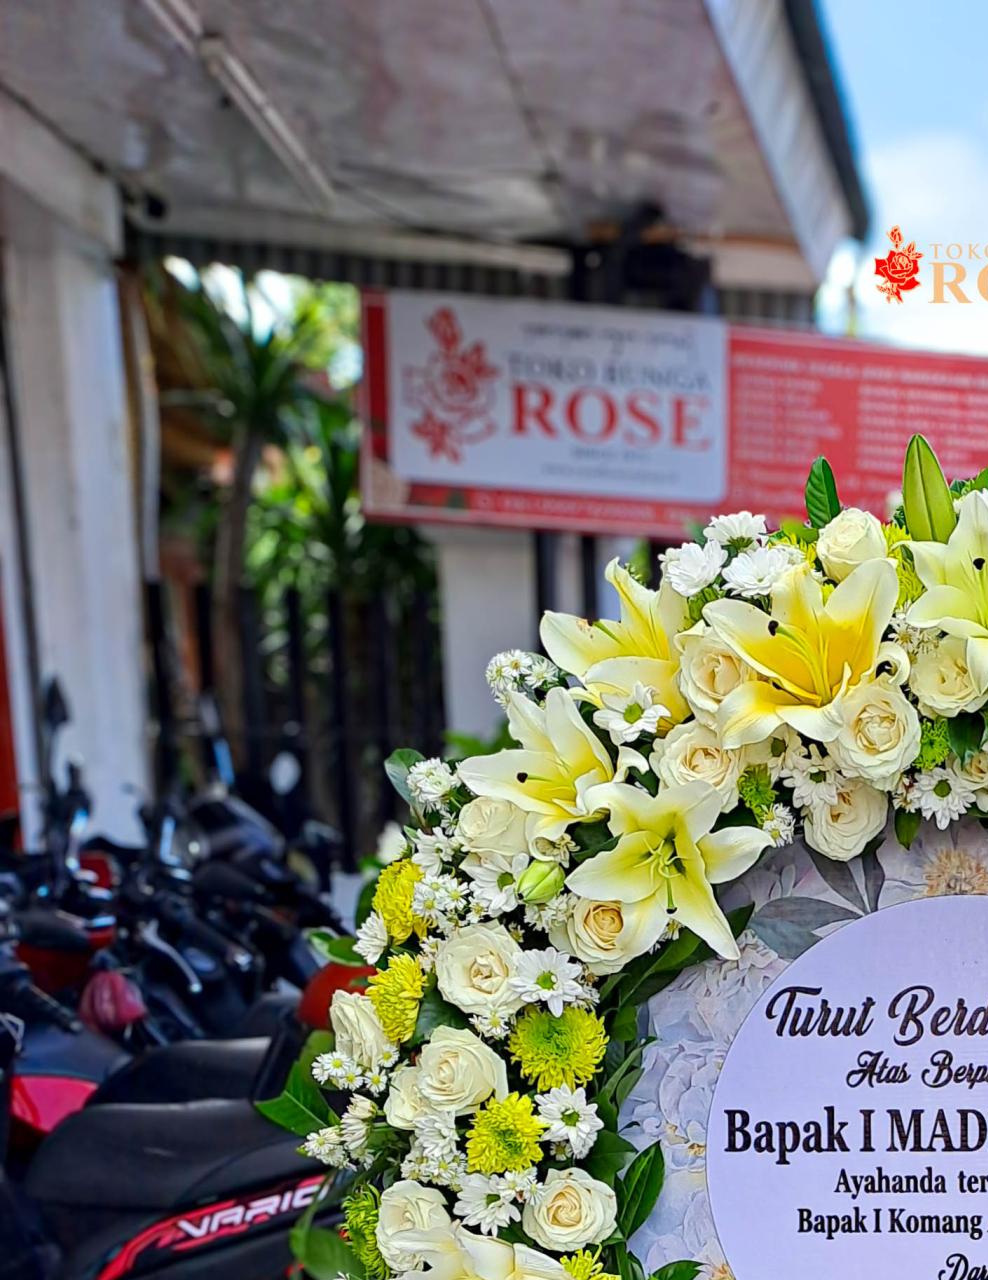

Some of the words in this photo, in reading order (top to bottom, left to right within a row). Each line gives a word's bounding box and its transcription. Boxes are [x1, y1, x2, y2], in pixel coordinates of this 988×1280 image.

[510, 380, 712, 451] ROSE
[765, 984, 877, 1037] Turut
[845, 1050, 912, 1089] Atas
[723, 1105, 851, 1166] Bapak
[859, 1109, 876, 1153] I
[833, 1166, 948, 1199] Ayahanda
[796, 1206, 869, 1241] Bapak
[872, 1208, 883, 1234] I
[887, 1208, 984, 1241] Komang
